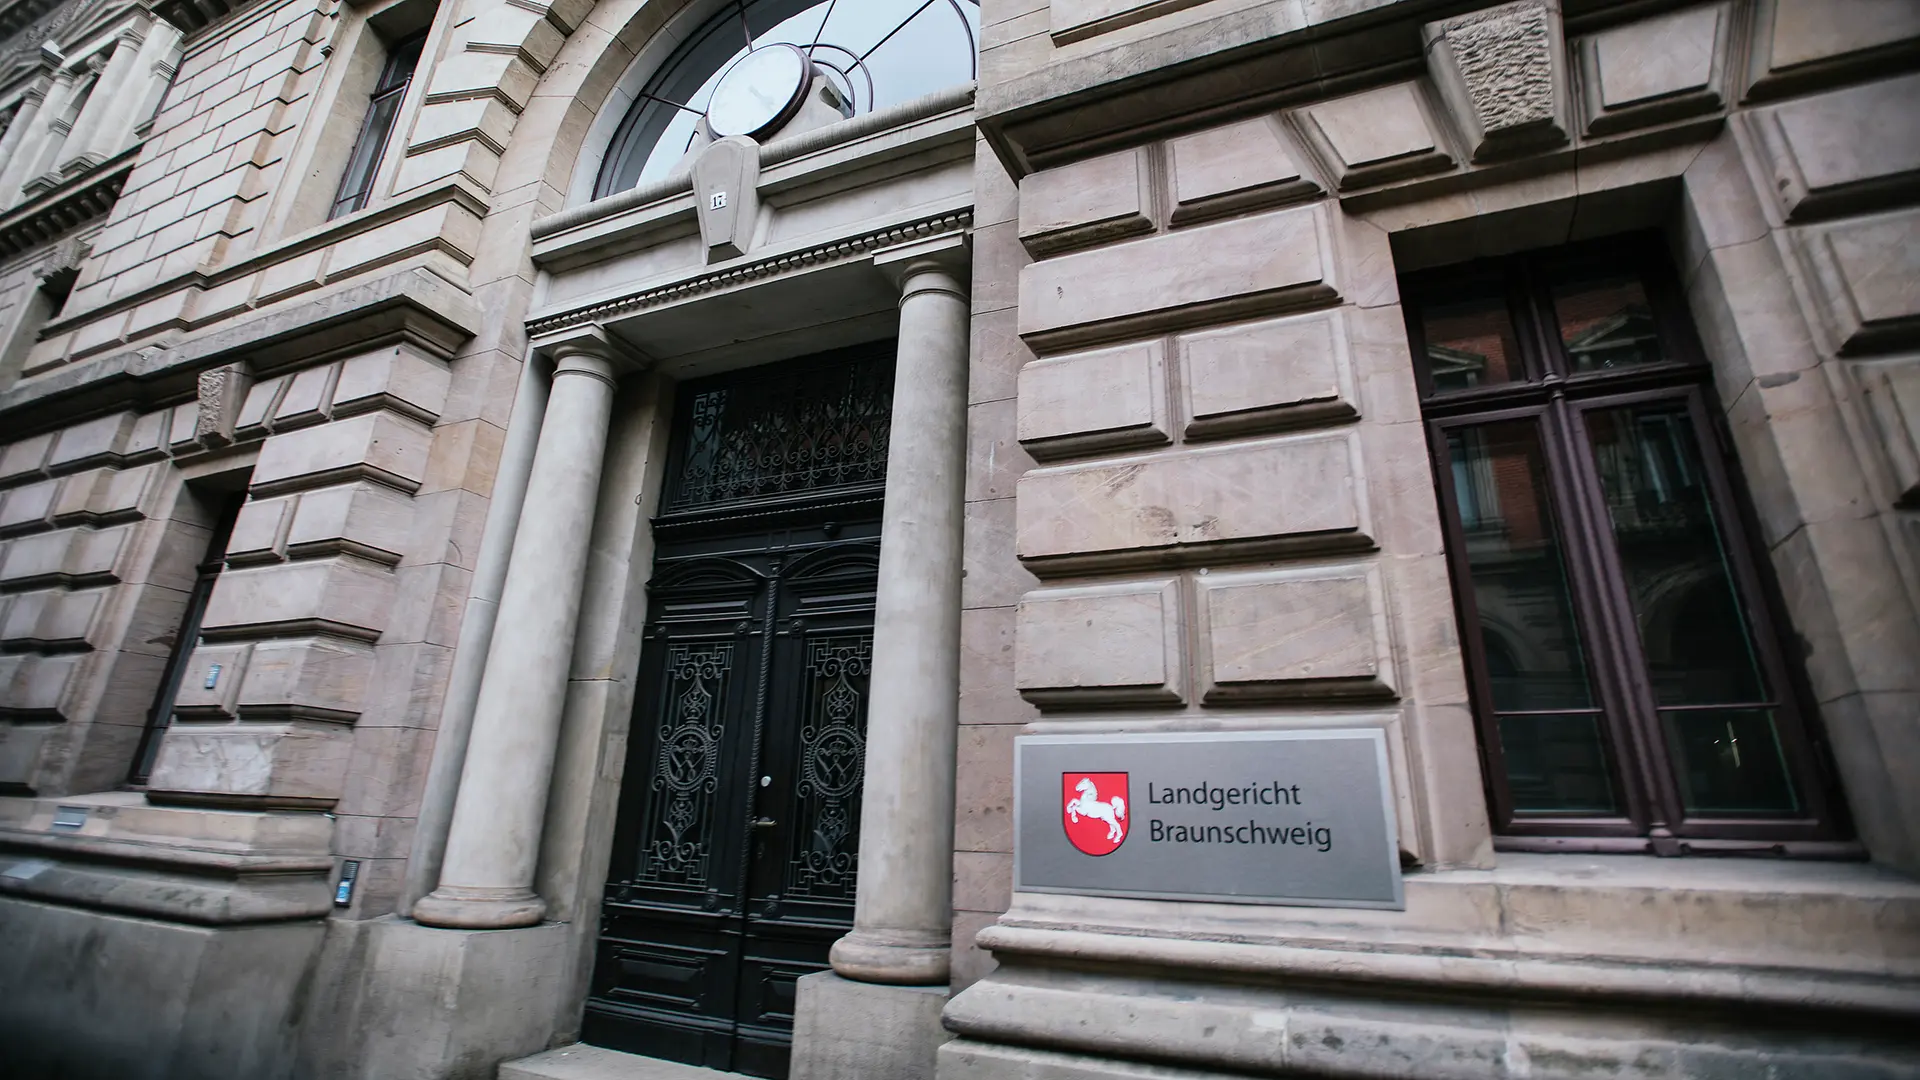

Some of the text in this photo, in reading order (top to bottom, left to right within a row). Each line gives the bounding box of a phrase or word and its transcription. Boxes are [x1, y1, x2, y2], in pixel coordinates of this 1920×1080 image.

[713, 194, 723, 207] 17
[1148, 781, 1302, 810] Landgericht
[1149, 820, 1332, 852] Braunschweig
